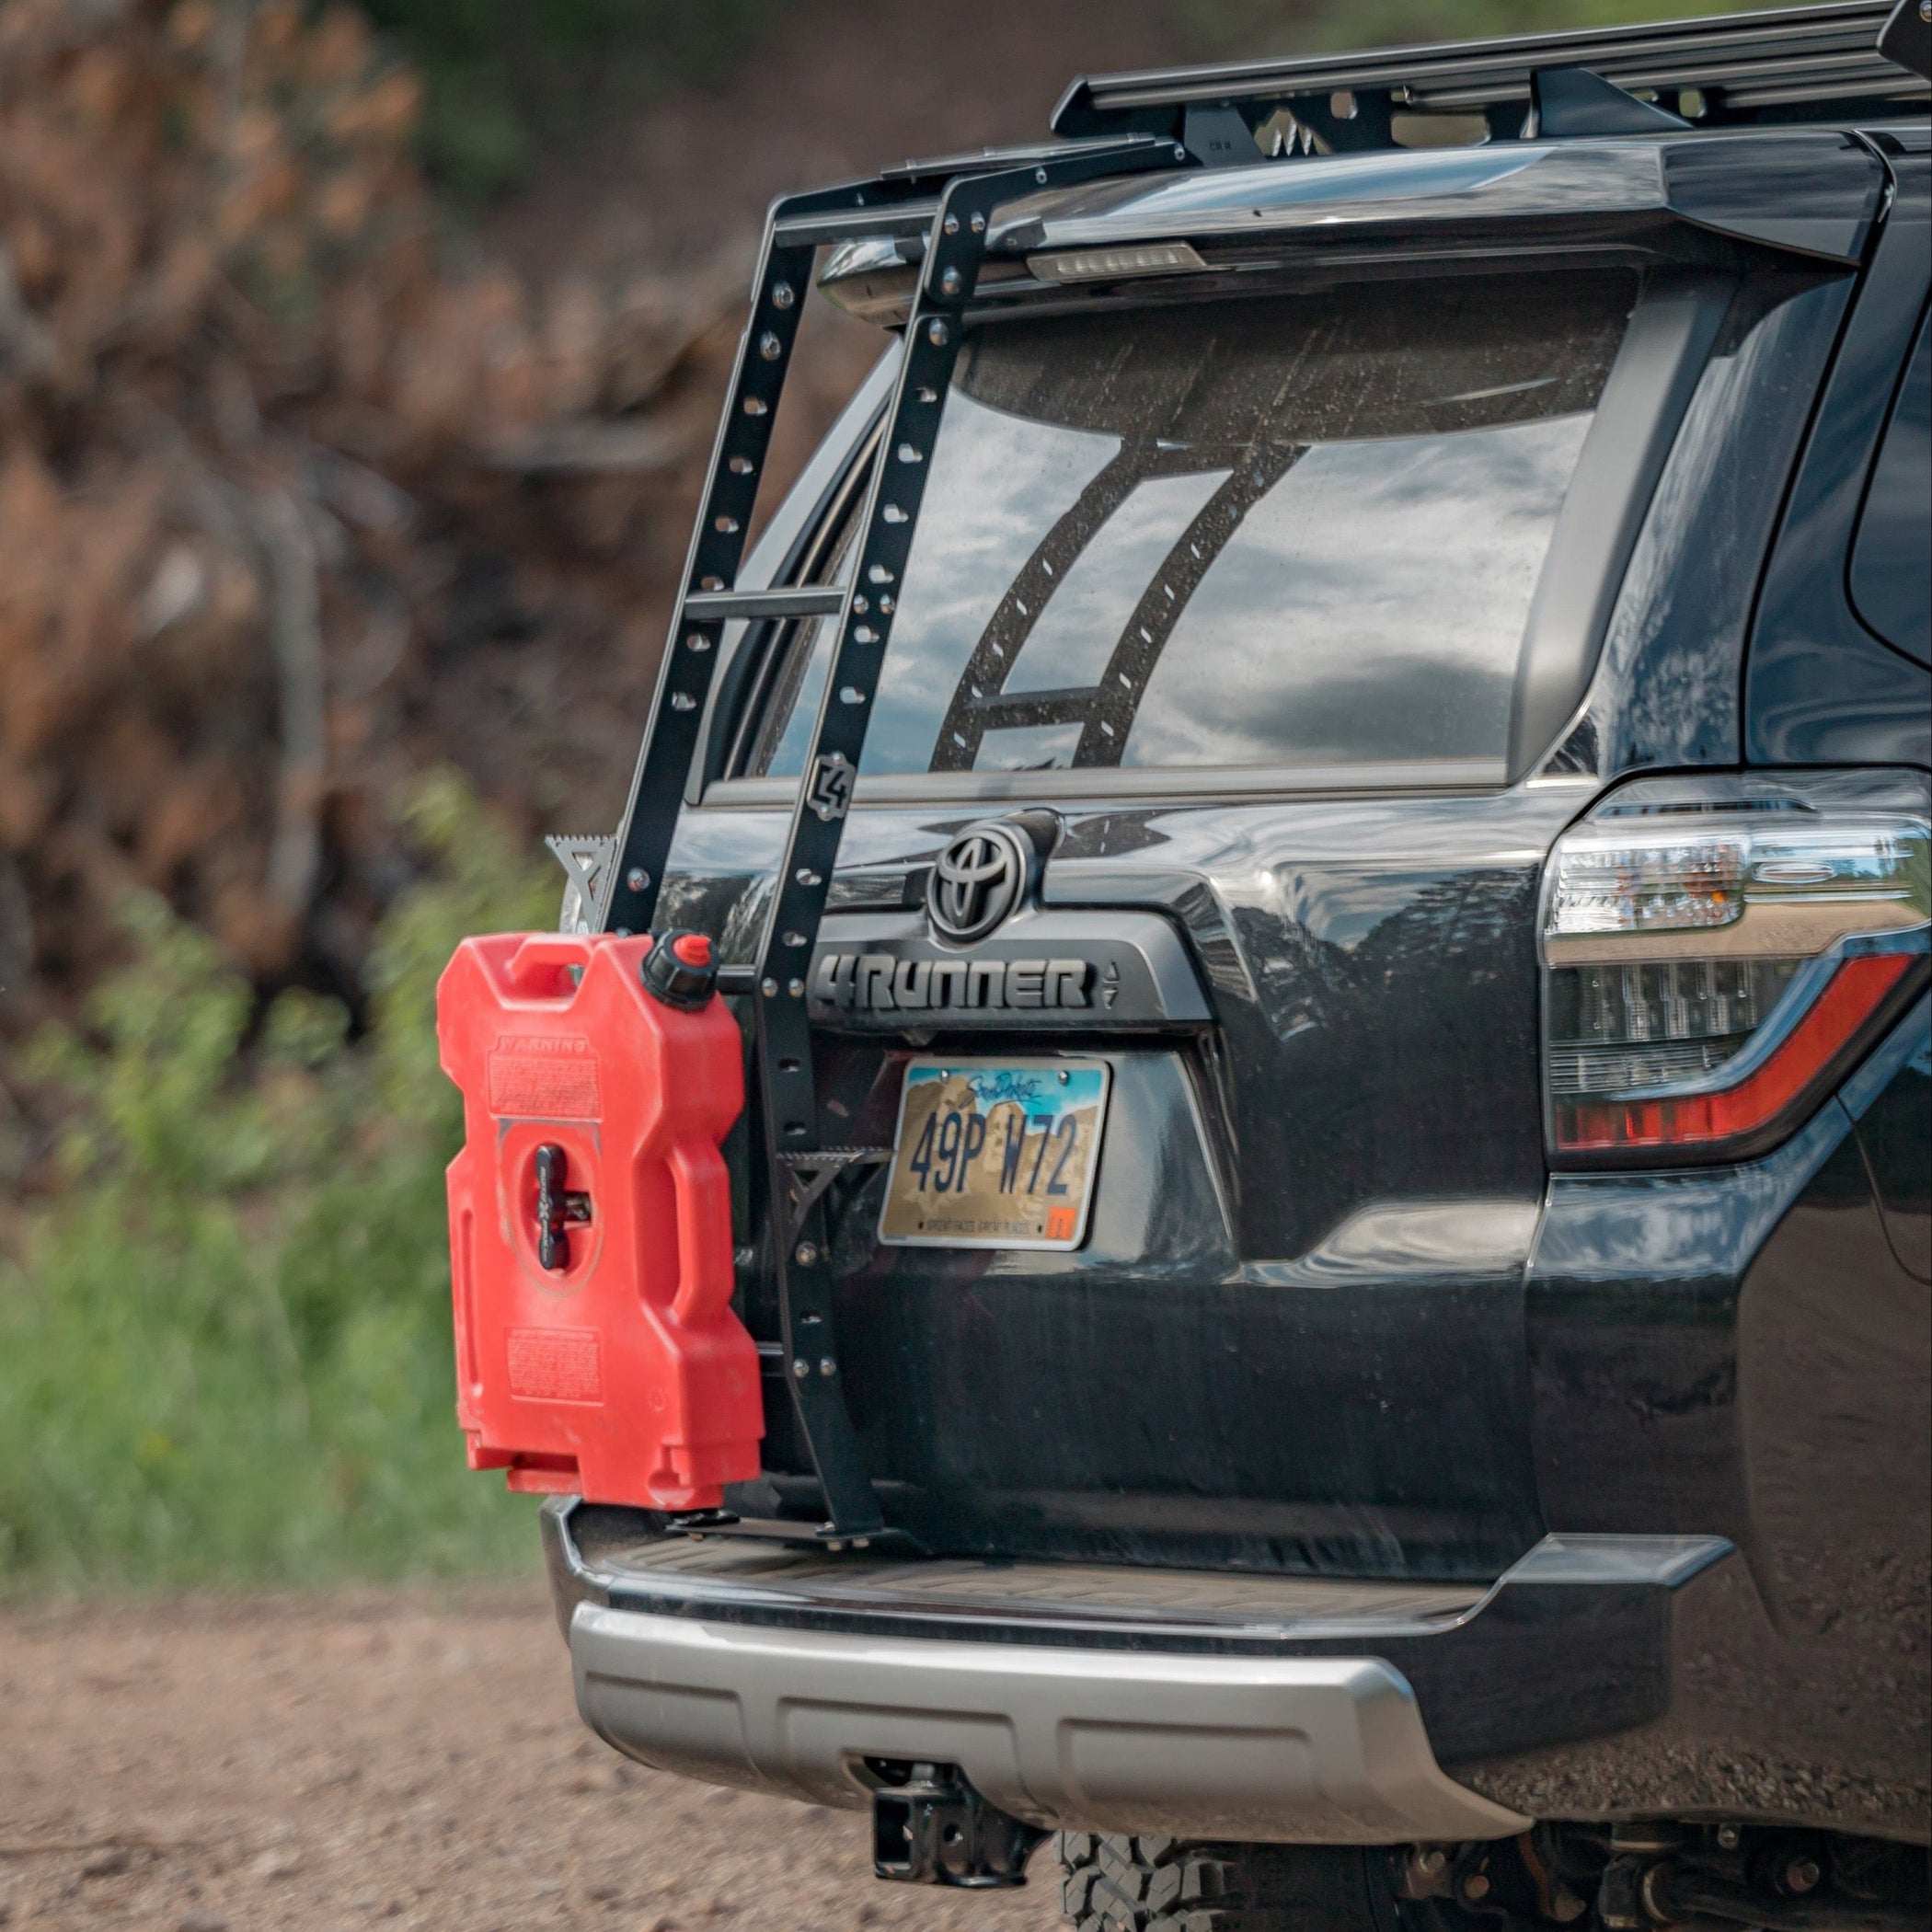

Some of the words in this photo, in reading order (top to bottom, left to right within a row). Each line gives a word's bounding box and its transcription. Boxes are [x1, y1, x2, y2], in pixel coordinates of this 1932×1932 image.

[499, 1036, 588, 1053] WARNING
[911, 1111, 986, 1193] 49P
[999, 1113, 1076, 1196] W72
